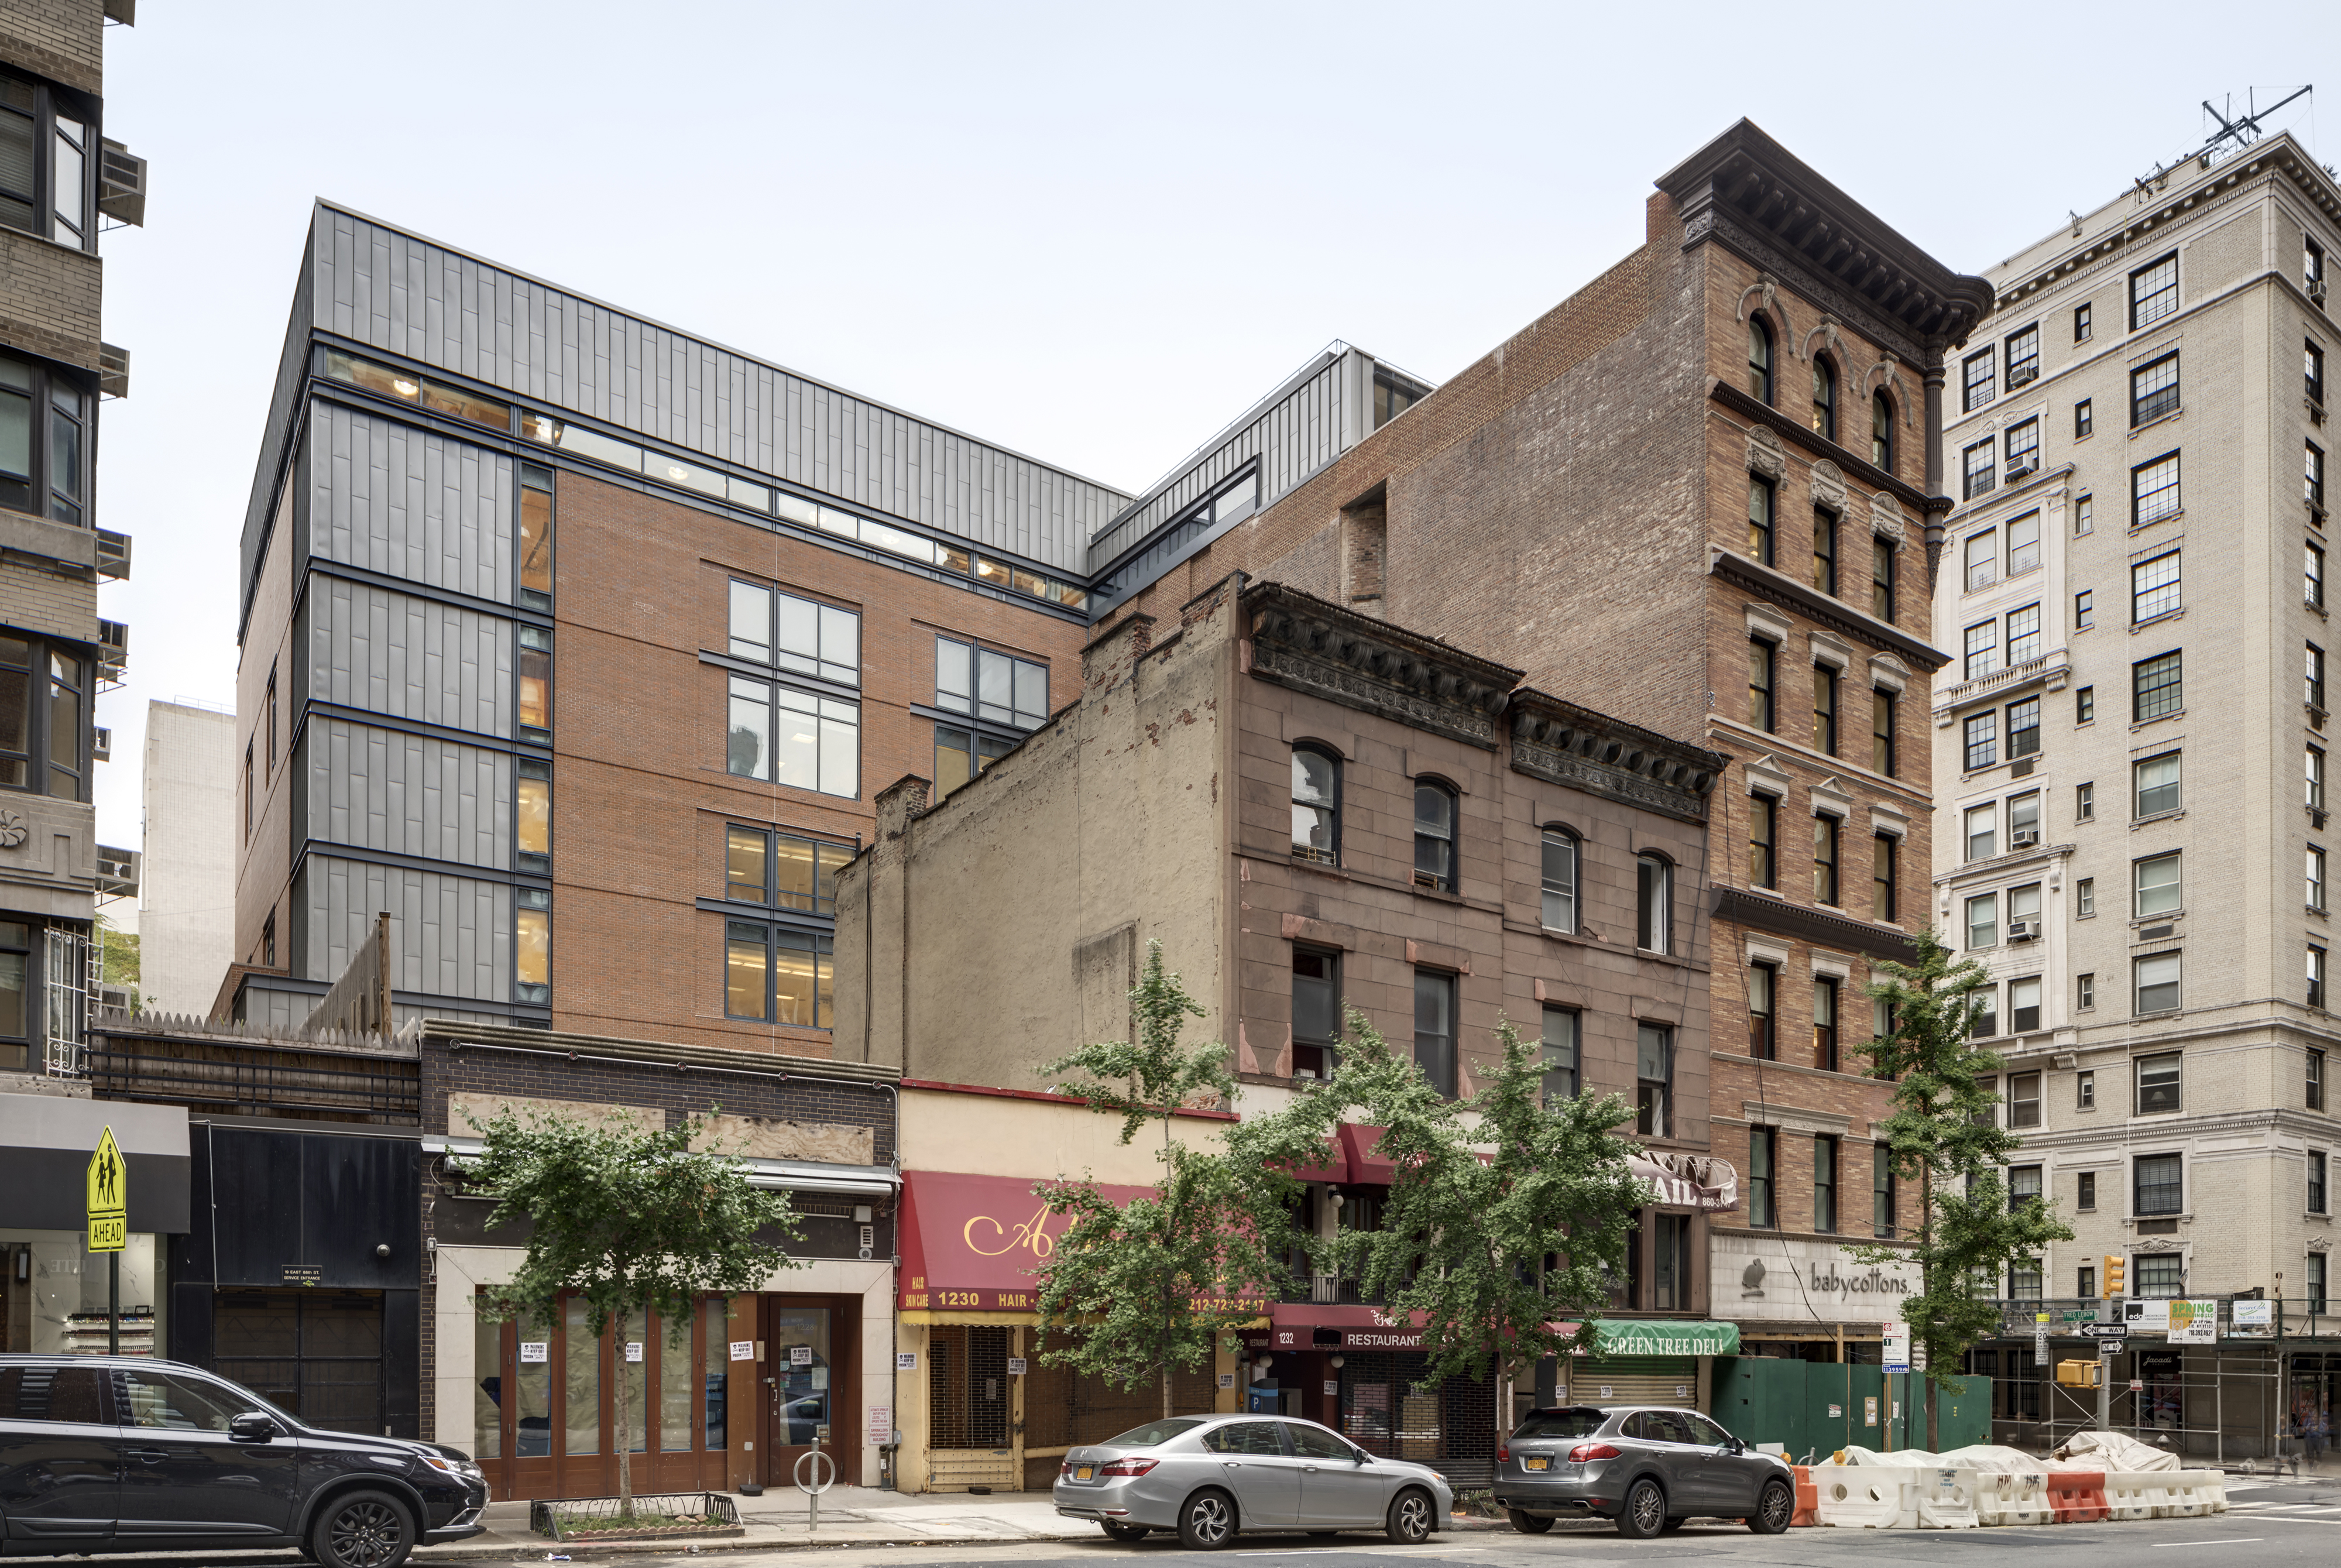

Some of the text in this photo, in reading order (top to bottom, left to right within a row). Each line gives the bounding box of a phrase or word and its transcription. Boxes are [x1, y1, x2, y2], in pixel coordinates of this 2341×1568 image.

[1702, 1196, 1730, 1208] 860-3
[93, 1222, 121, 1243] AHEAD
[912, 1277, 924, 1289] HAIR
[905, 1294, 928, 1307] SKIN CARE
[939, 1292, 979, 1305] 1230
[998, 1294, 1027, 1306] HAIR
[2172, 1303, 2213, 1313] SPRING
[1279, 1332, 1422, 1346] 1232 RESTAURANT
[1607, 1337, 1724, 1356] GREEN TREE DELI
[1254, 1397, 1259, 1409] P
